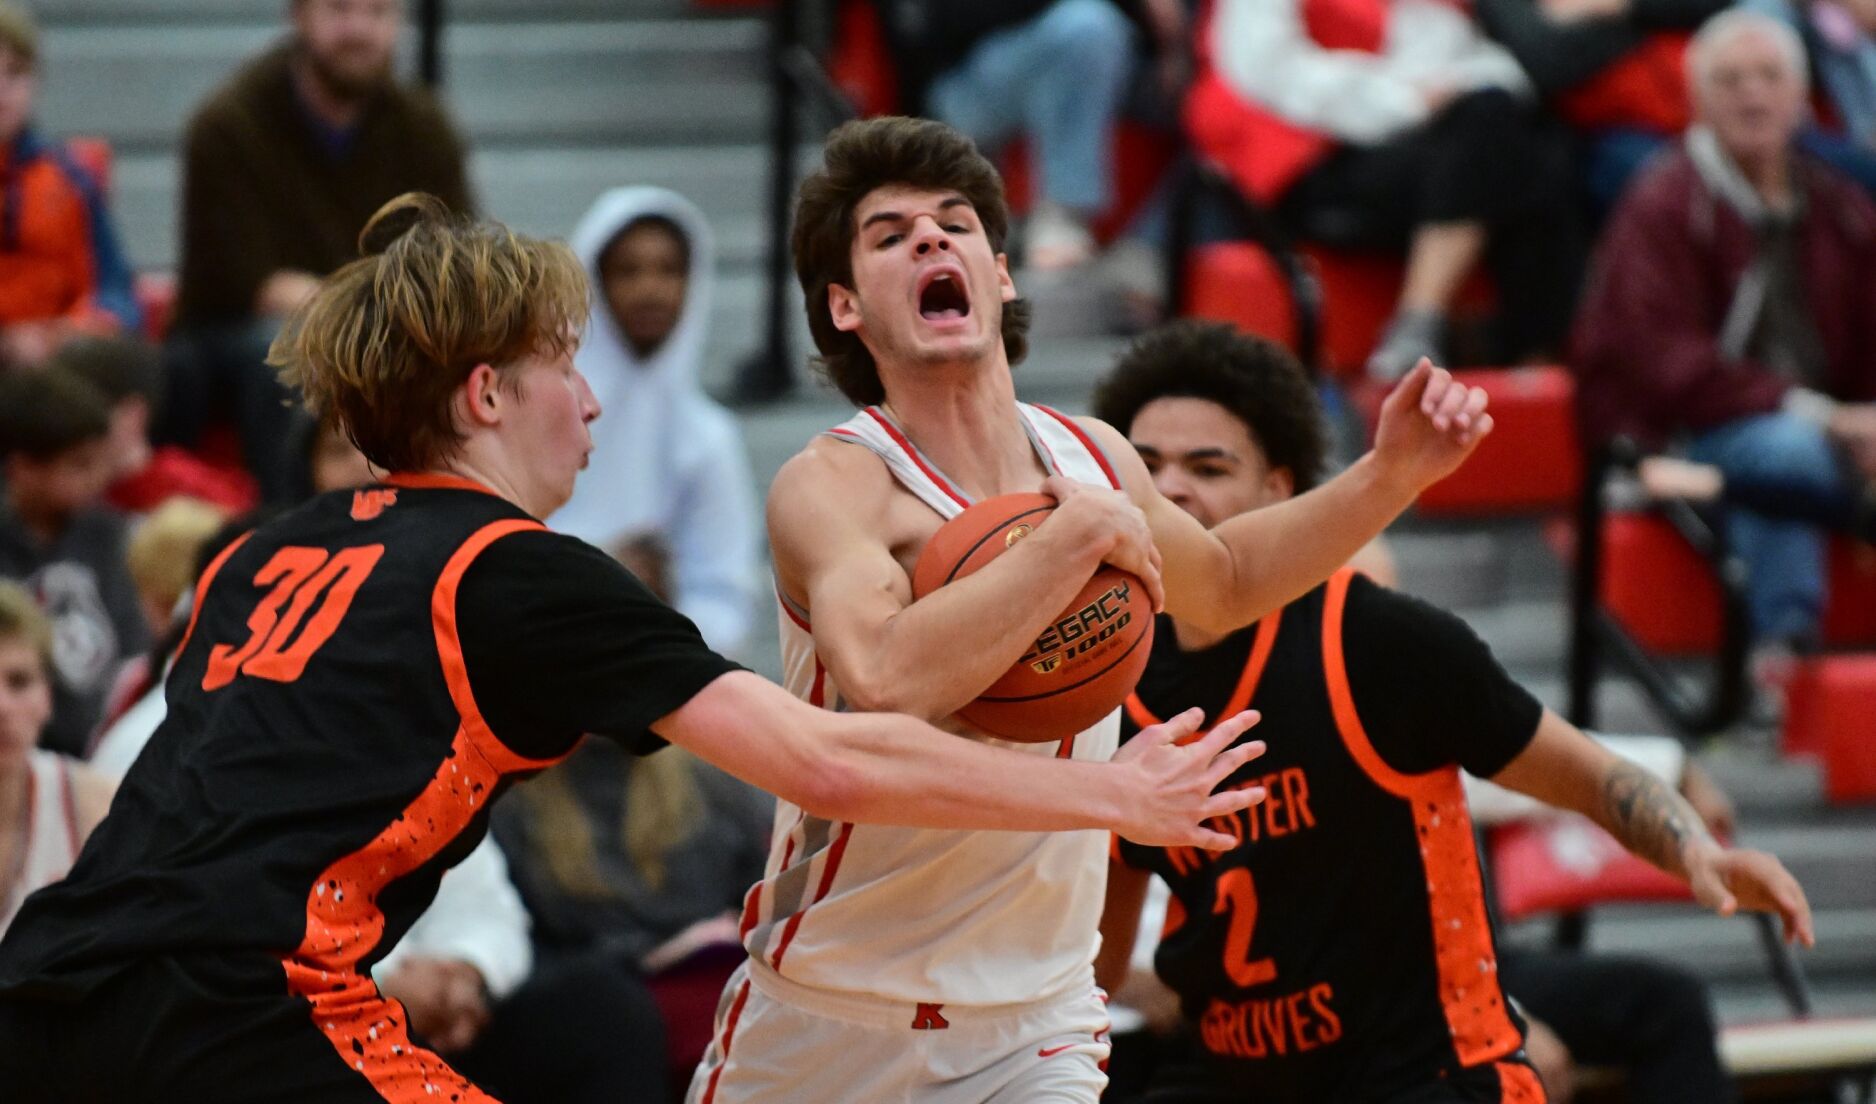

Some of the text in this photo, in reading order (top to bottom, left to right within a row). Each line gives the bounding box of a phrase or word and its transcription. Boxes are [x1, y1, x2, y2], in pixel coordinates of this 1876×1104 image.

[202, 543, 385, 692] 30
[1065, 611, 1132, 660] 1000
[1212, 866, 1278, 988] 2
[911, 1002, 950, 1030] K
[1200, 982, 1343, 1058] GROVES
